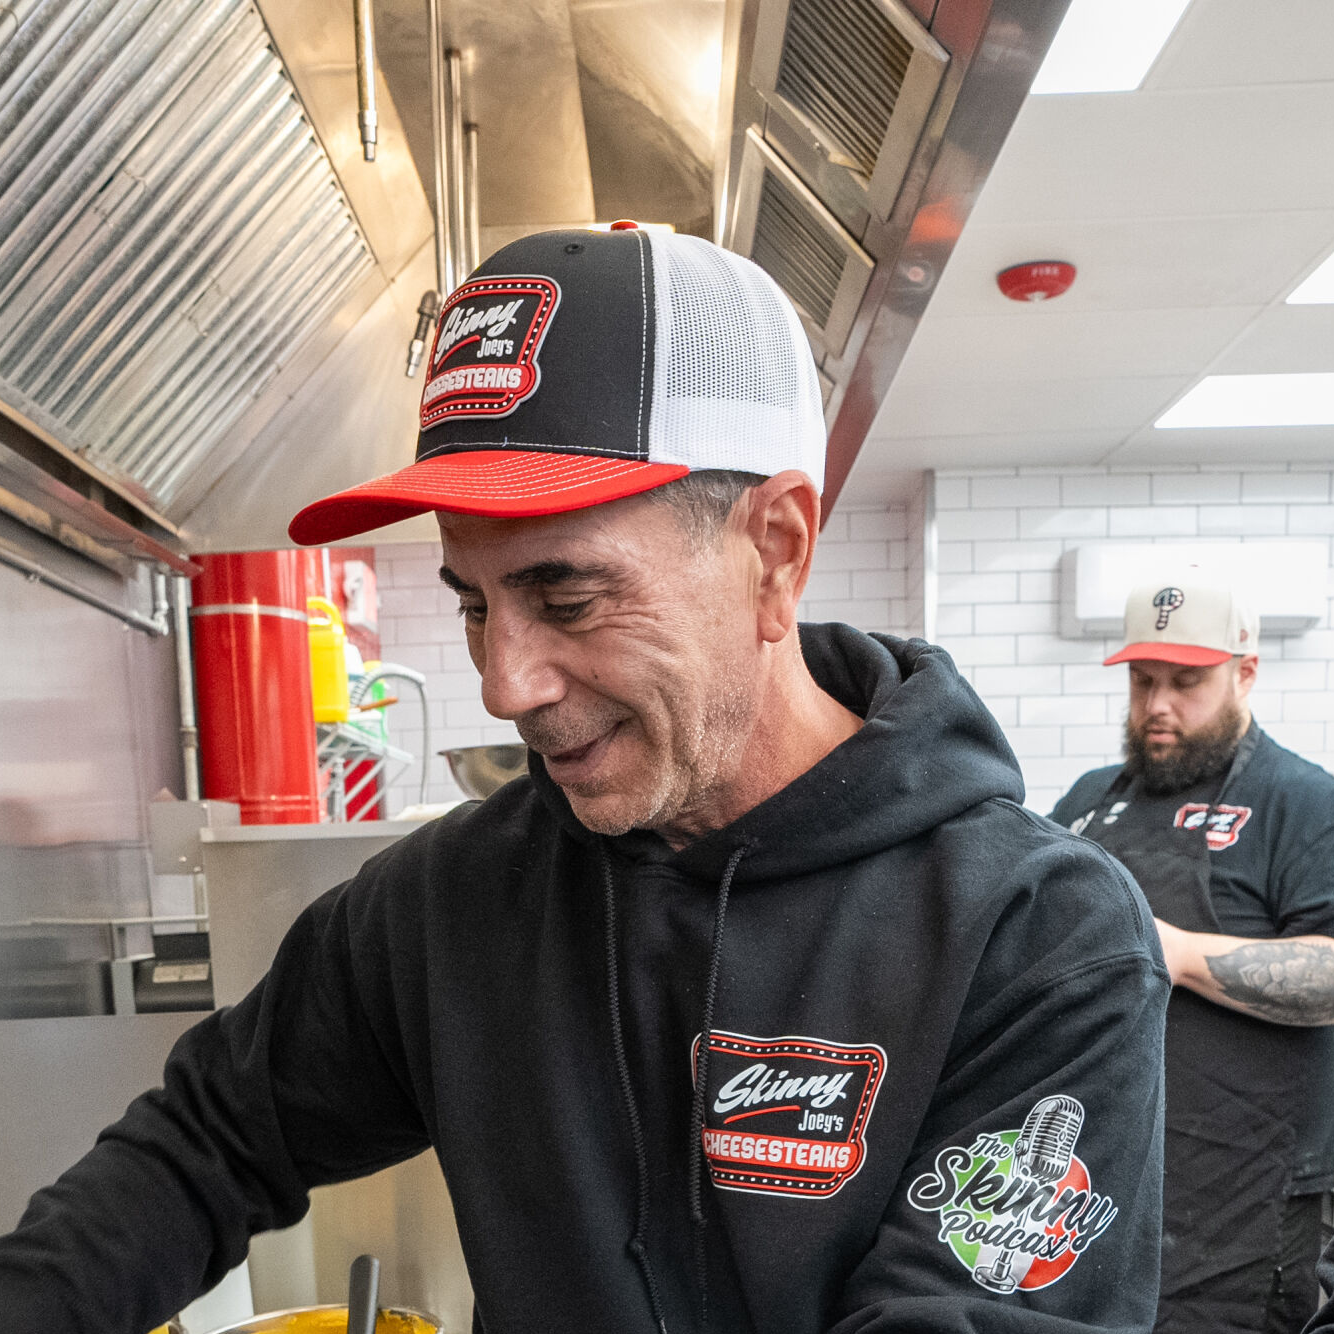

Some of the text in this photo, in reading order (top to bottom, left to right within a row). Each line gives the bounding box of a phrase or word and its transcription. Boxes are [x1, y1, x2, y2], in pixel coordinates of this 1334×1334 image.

[434, 299, 524, 365] Skinny
[476, 337, 514, 358] Joey's
[713, 1063, 854, 1114] Skinny
[797, 1110, 844, 1133] Joey's
[703, 1132, 852, 1169] CHEESESTEAKS
[971, 1134, 1012, 1158] The
[908, 1147, 1118, 1252] Skinny
[939, 1210, 1070, 1259] Podcast
